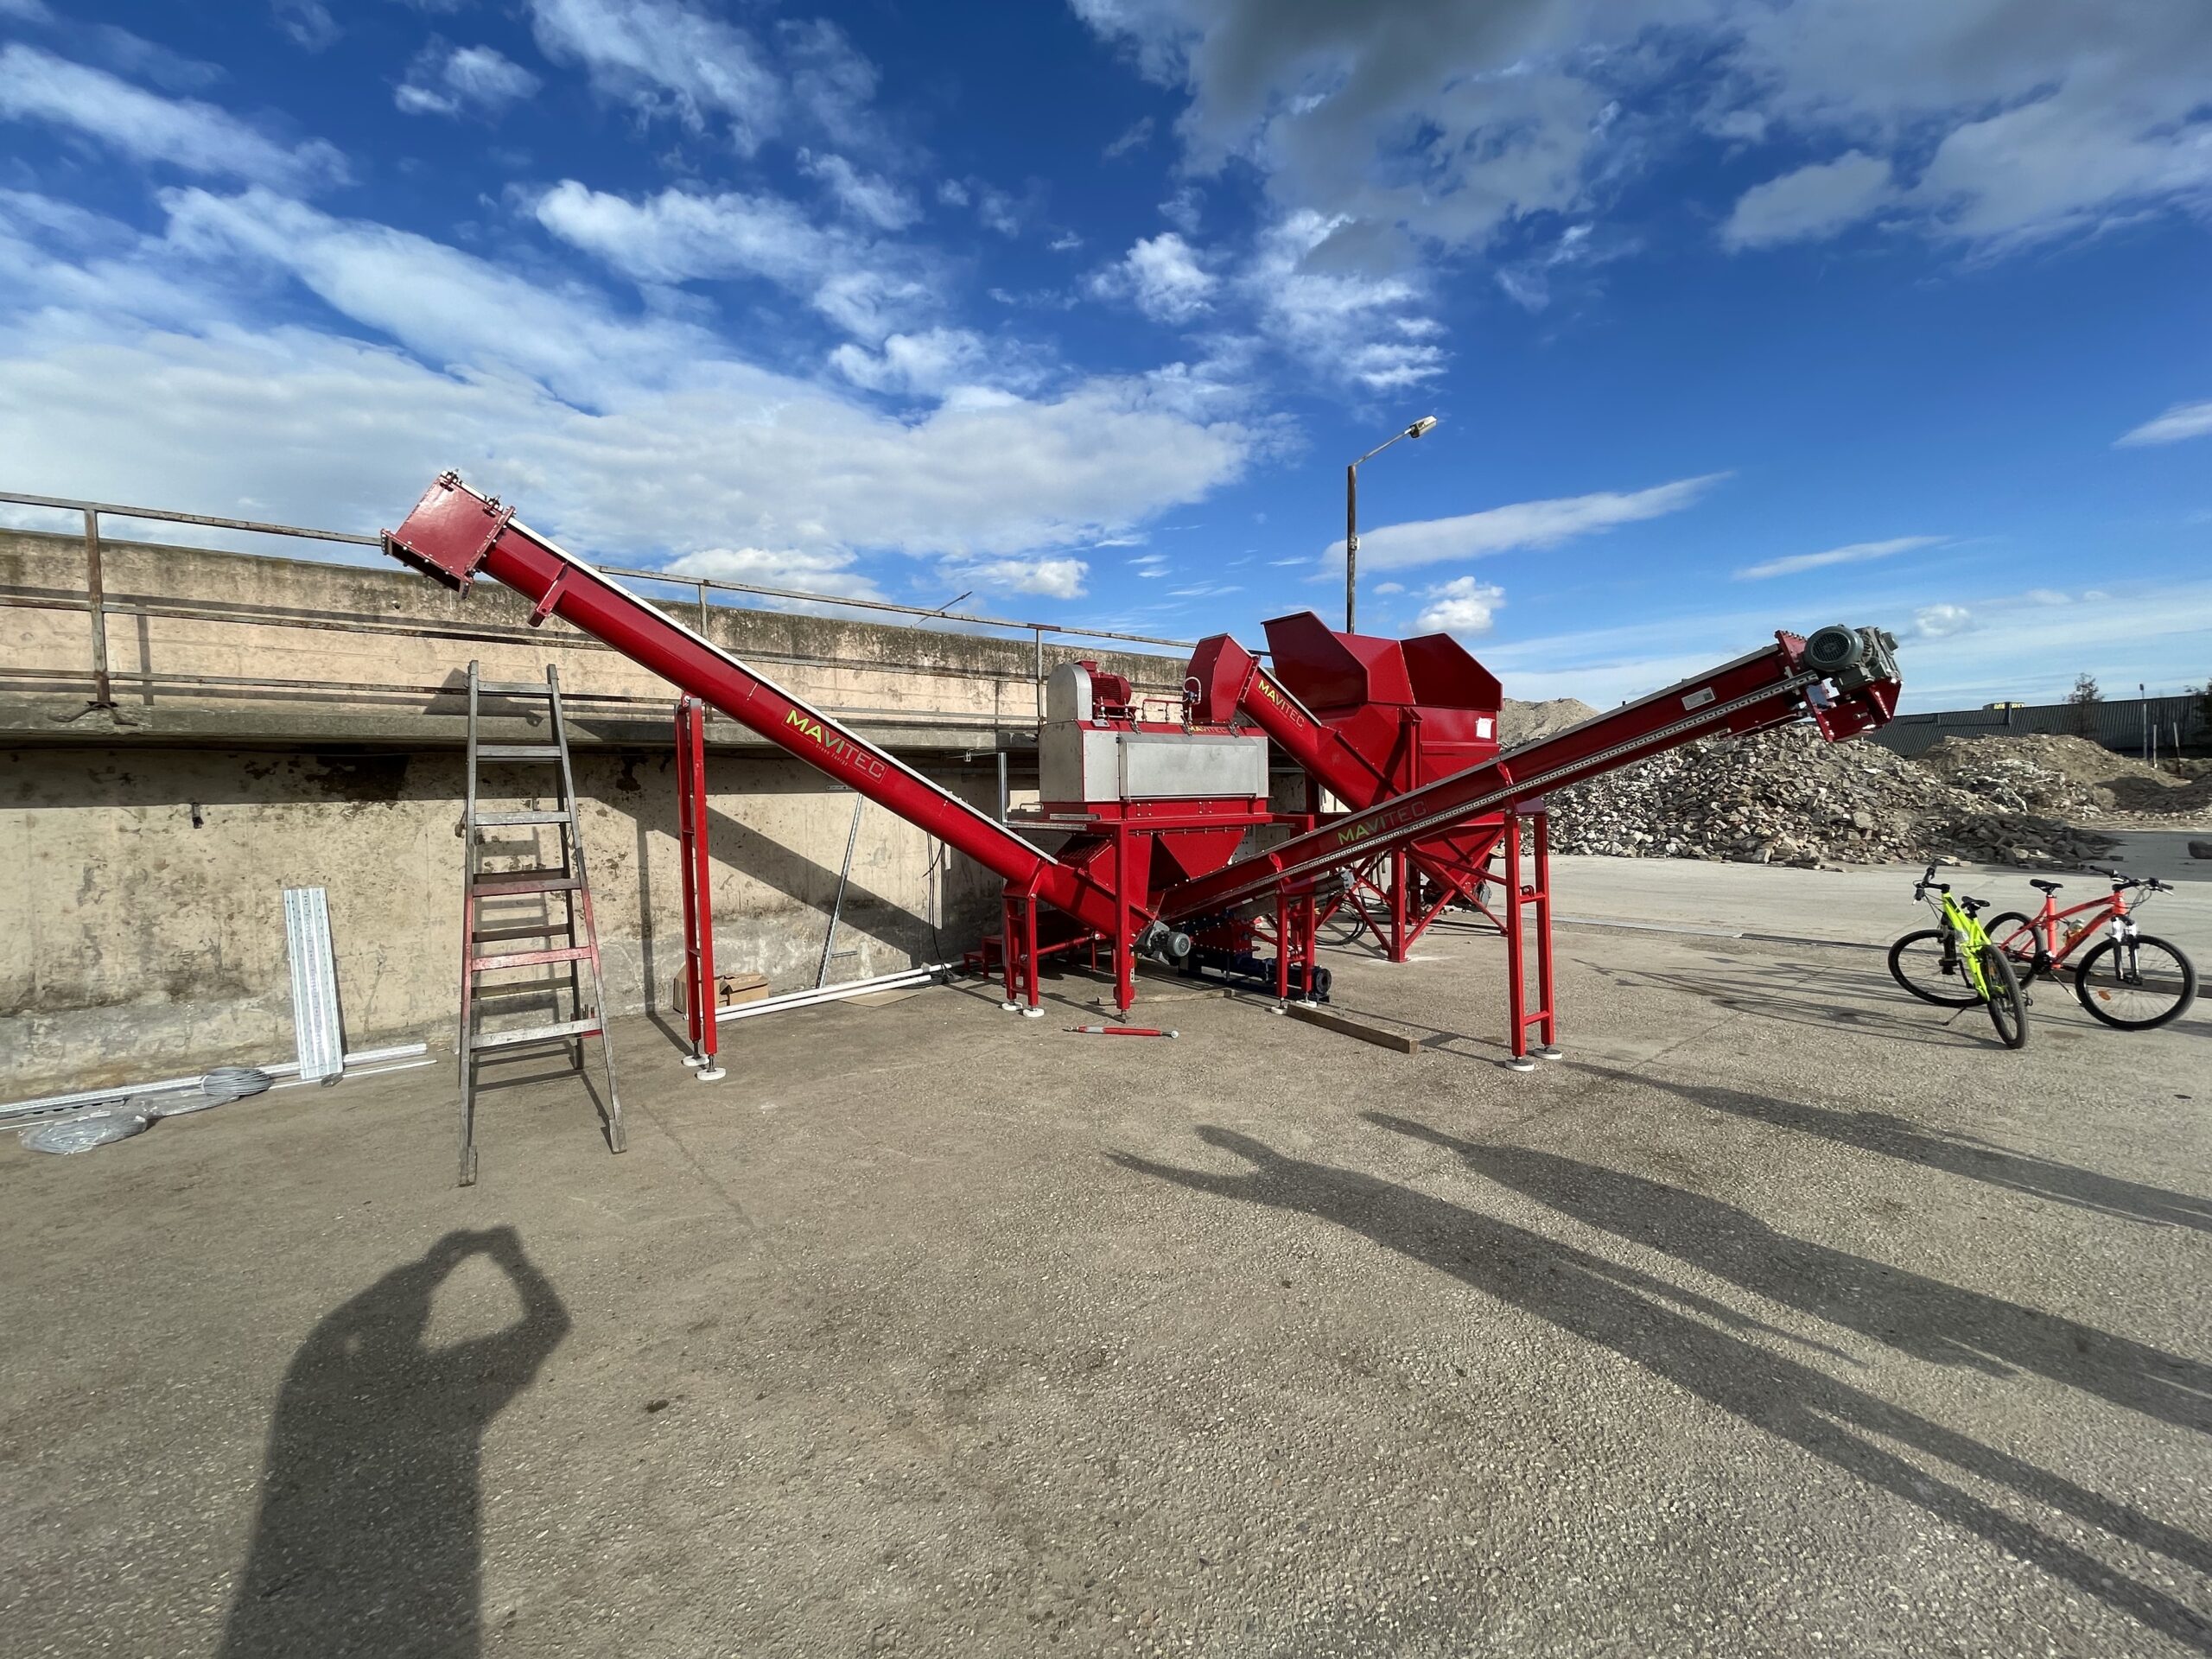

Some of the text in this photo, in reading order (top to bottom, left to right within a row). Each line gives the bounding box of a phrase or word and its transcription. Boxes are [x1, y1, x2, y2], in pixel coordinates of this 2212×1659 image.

[1258, 679, 1305, 728] MAVITEC
[785, 709, 885, 779] MAVITEC
[1338, 801, 1427, 845] MAVITEC
